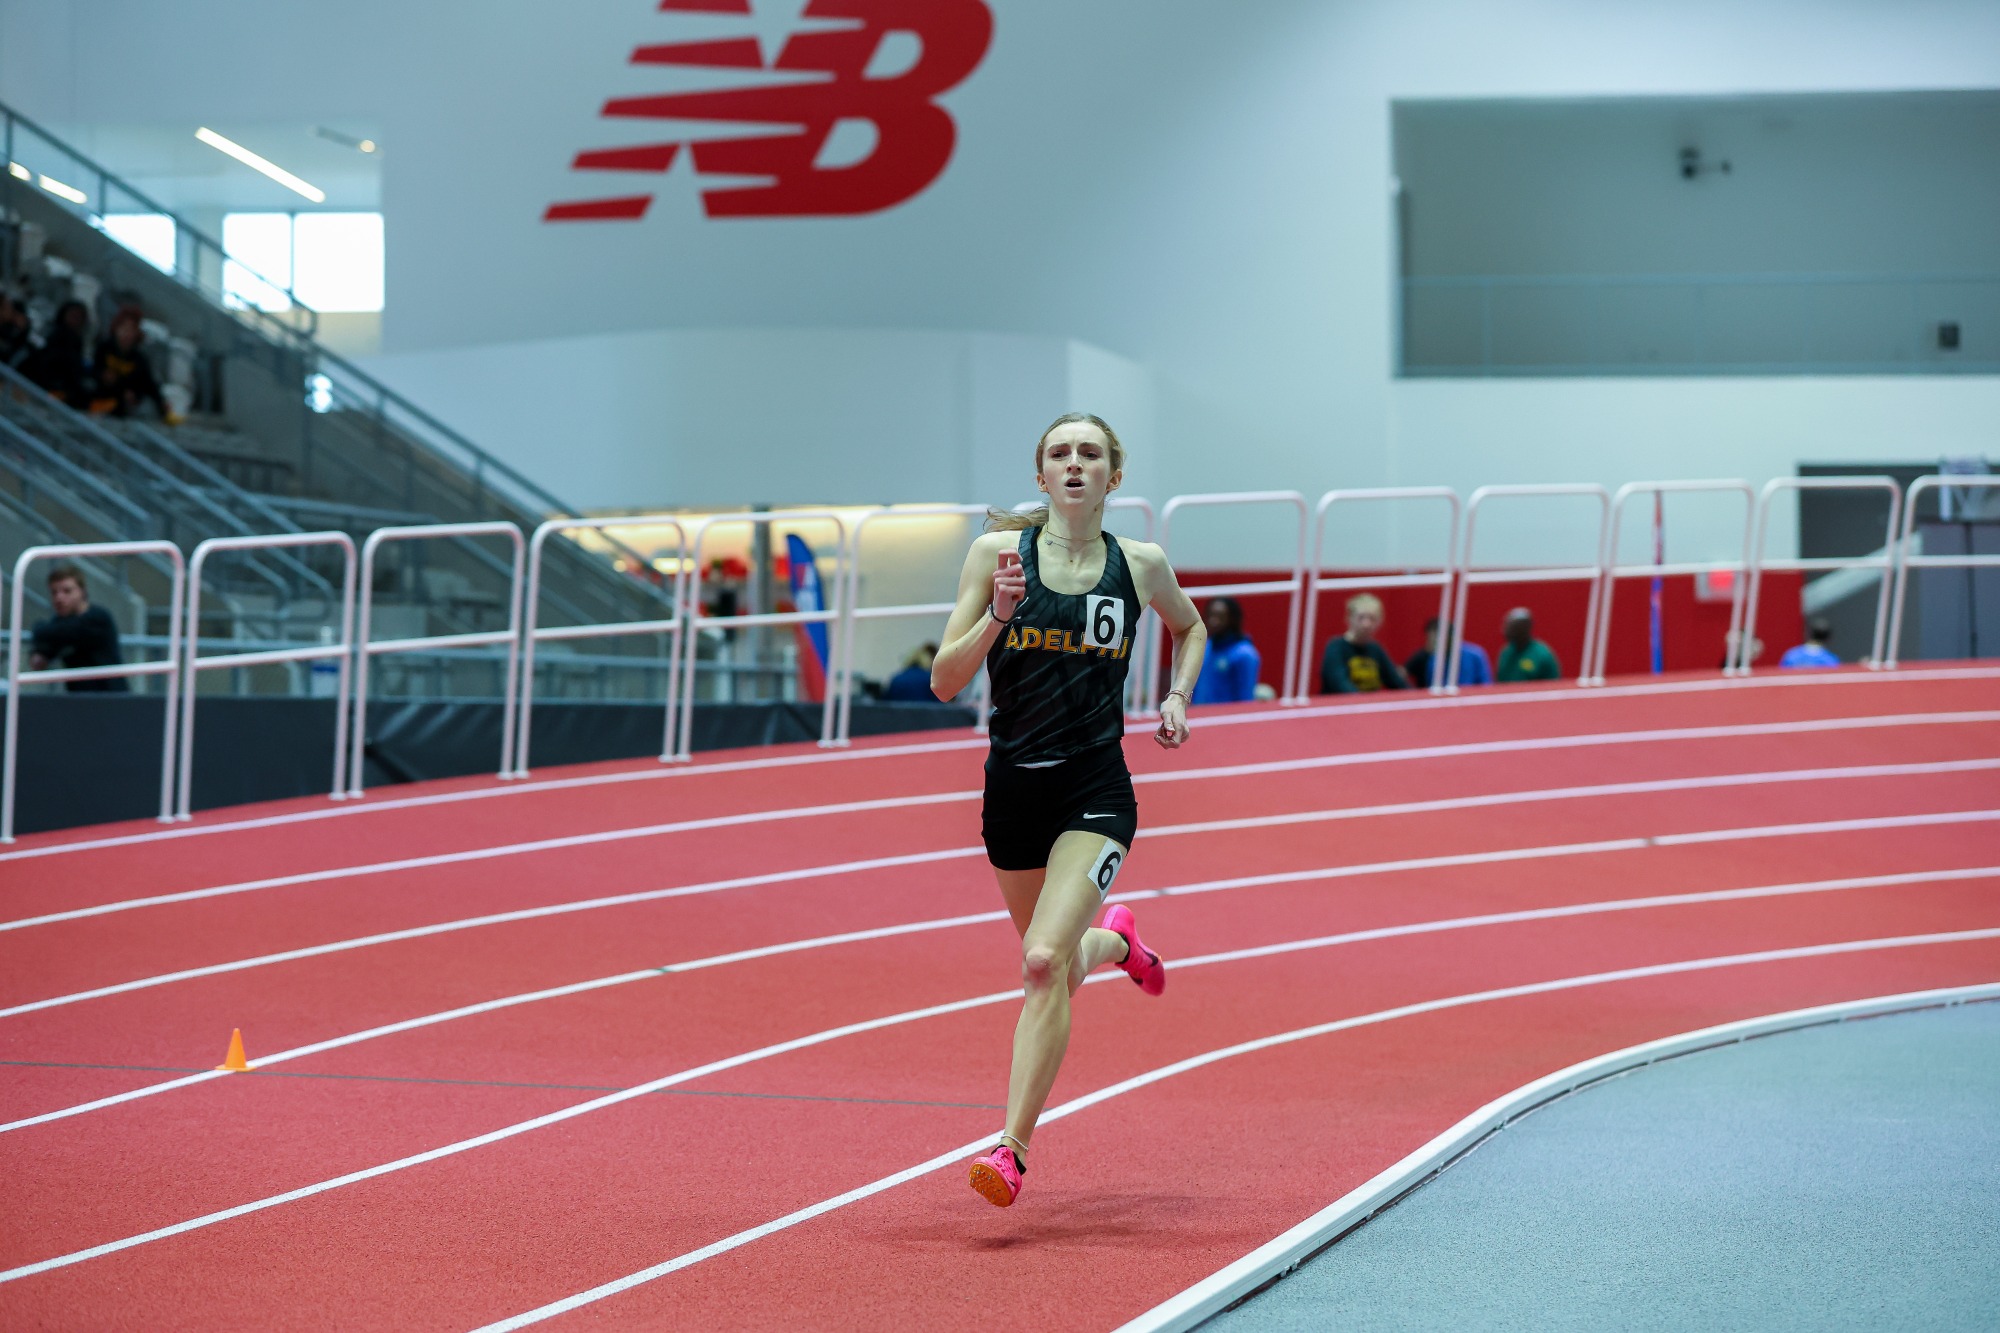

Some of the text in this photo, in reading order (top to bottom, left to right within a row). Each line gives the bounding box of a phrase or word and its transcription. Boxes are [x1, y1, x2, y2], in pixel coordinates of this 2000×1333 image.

[1004, 624, 1129, 659] ADELI
[1093, 599, 1115, 645] 6
[1097, 851, 1121, 891] 6
